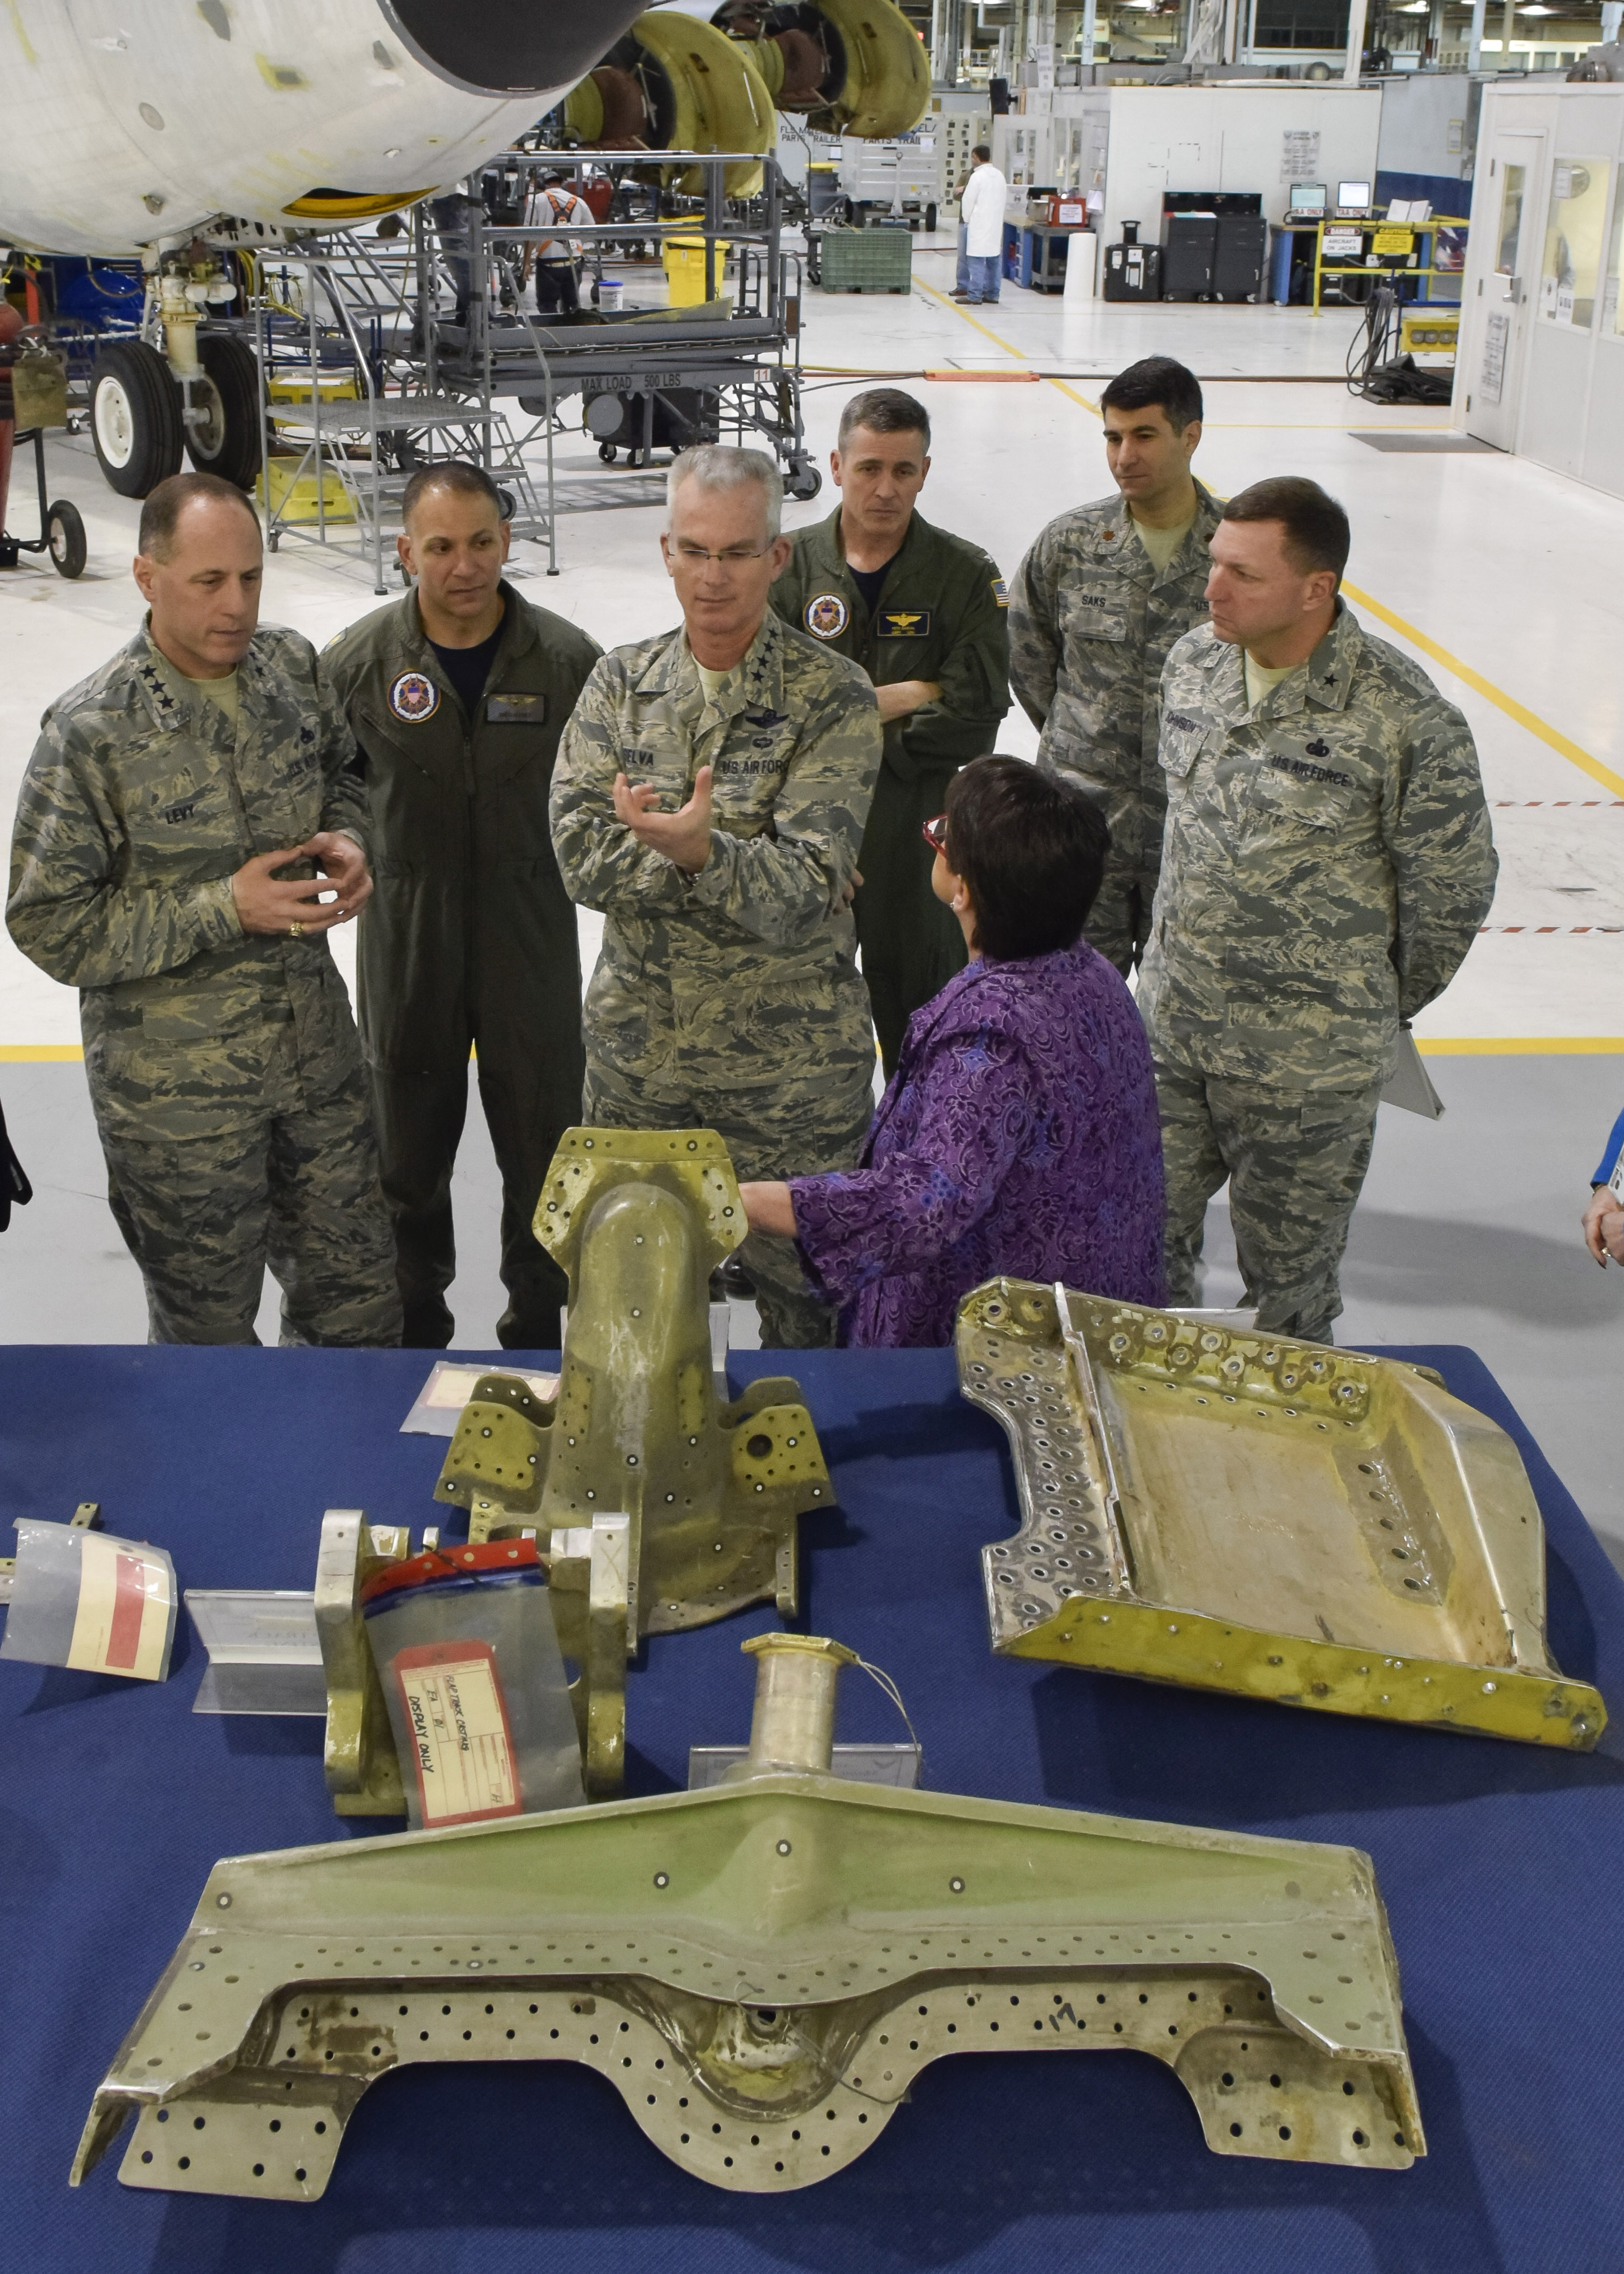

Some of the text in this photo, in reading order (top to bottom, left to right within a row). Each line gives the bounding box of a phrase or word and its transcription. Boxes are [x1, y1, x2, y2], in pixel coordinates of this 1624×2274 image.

[581, 374, 681, 391] MAX LOAD 500 LBS
[755, 370, 768, 381] 11
[1081, 595, 1106, 607] SAKS
[742, 760, 759, 774] AIR
[1291, 761, 1311, 776] AIR
[1311, 764, 1349, 787] FORCE
[165, 803, 194, 825] LEVY
[408, 1695, 429, 1739] DISPLAY
[418, 1743, 435, 1773] ONLY
